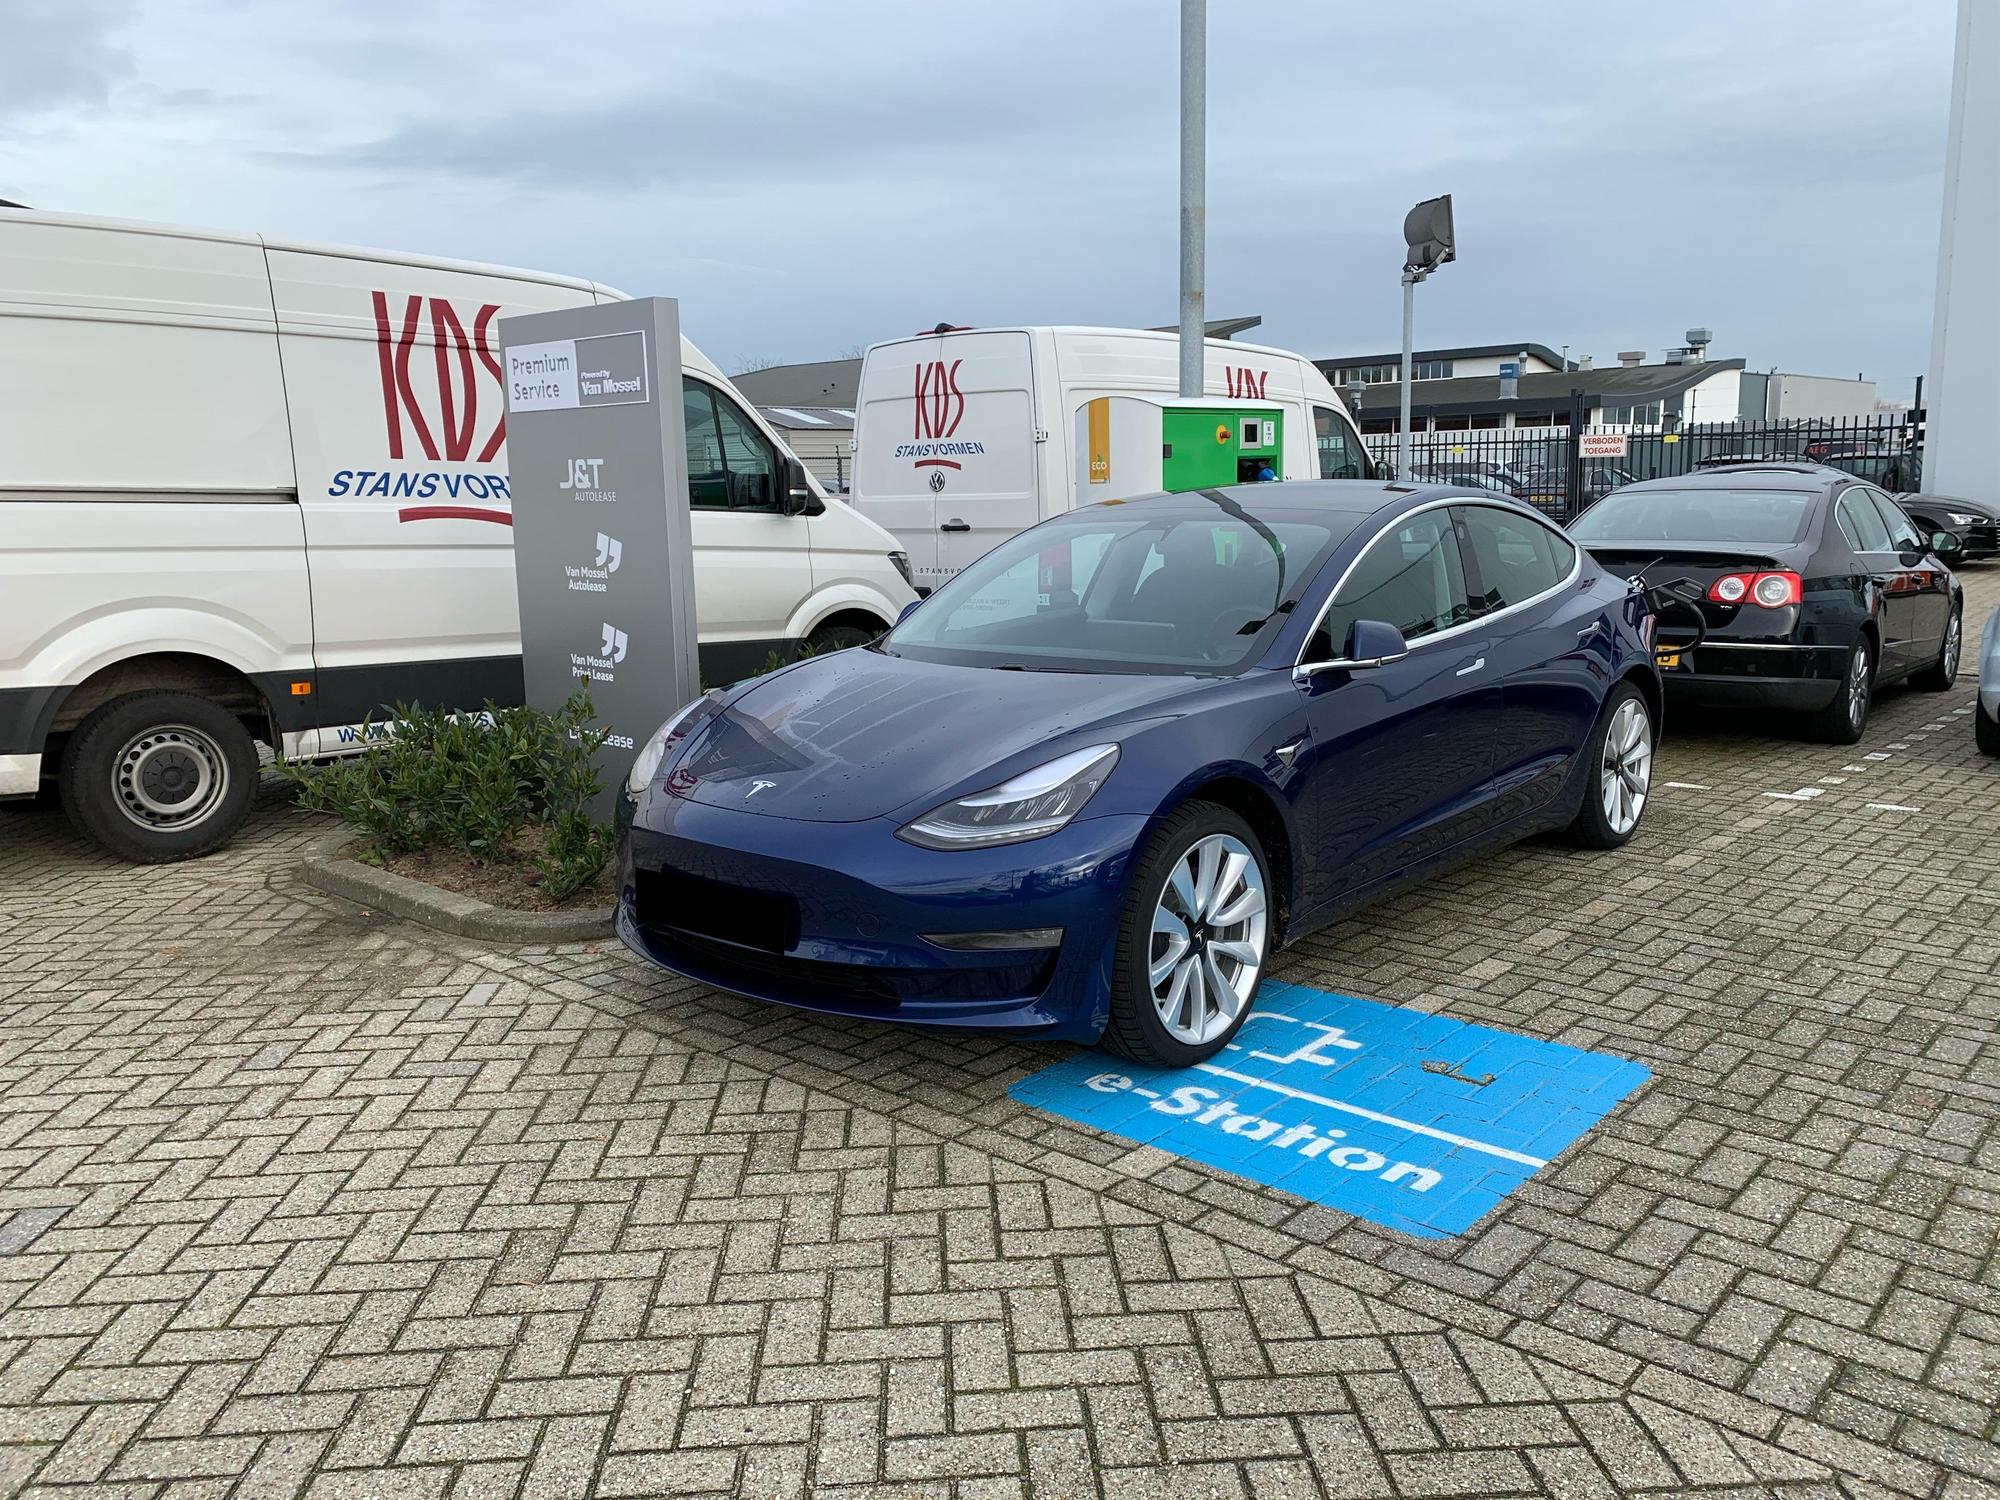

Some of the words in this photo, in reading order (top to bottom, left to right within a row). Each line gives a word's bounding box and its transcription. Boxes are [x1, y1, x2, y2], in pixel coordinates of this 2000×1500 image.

[512, 354, 570, 375] Premium
[371, 290, 507, 463] KDS
[581, 371, 603, 379] Powered
[514, 380, 560, 400] Service
[581, 381, 601, 395] Van
[603, 377, 640, 393] Mossel
[914, 359, 964, 439] KDS
[895, 442, 985, 457] STANSVORMEN
[1091, 461, 1107, 470] ECO
[560, 459, 603, 489] J&T
[328, 470, 512, 499] STANSVOR
[575, 491, 617, 502] AUTOLEASE
[565, 566, 580, 577] Van
[581, 567, 608, 579] Mossel
[569, 580, 607, 592] Autolease
[571, 654, 586, 665] Van
[587, 656, 614, 669] Mossel
[592, 669, 614, 681] Lease
[1085, 1073, 1443, 1192] e-Station
